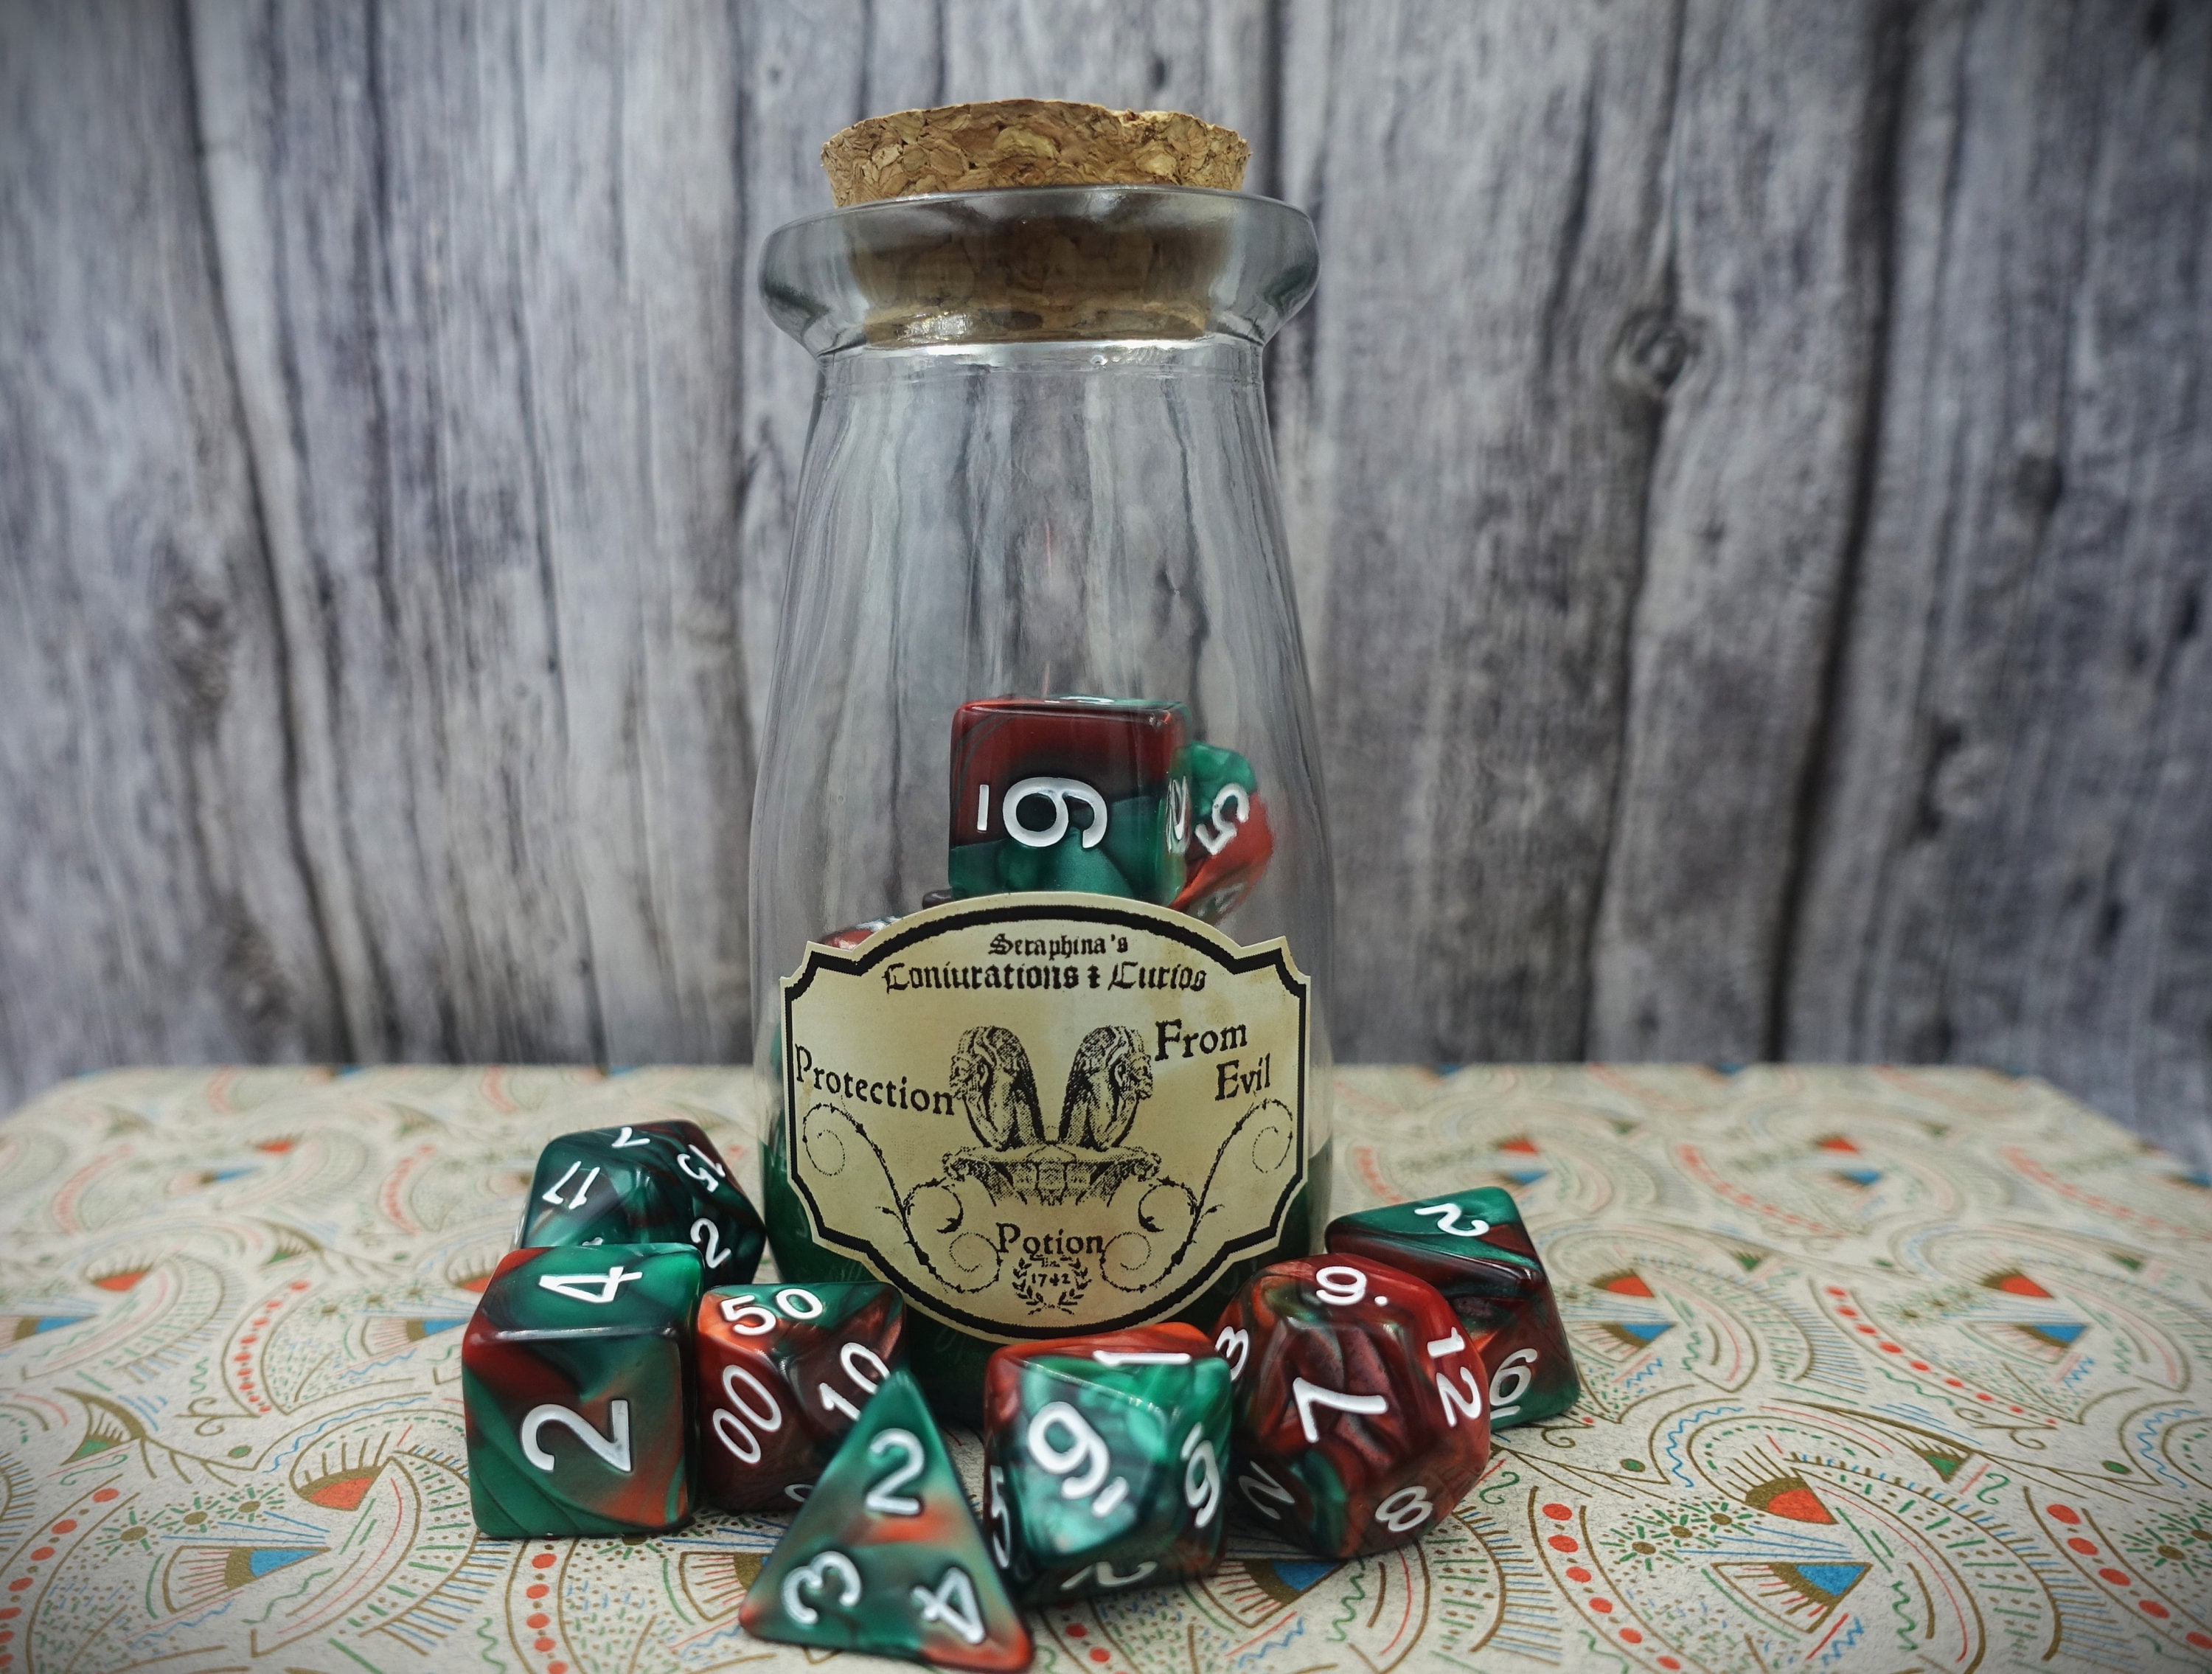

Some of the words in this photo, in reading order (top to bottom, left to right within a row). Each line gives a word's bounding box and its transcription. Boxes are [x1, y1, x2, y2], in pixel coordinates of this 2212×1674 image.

[988, 933, 1128, 961] Seraphina's
[1107, 961, 1207, 992] Curios
[1155, 1018, 1248, 1061] From
[795, 1043, 955, 1116] Protection
[1215, 1052, 1270, 1101] Evil
[677, 1144, 726, 1192] 15
[690, 1218, 732, 1268] 2
[995, 1222, 1104, 1255] Potion
[1414, 1203, 1490, 1237] 2
[538, 1265, 643, 1304] 4
[1032, 1273, 1071, 1288] 1742
[721, 1288, 824, 1336] 50
[1092, 1350, 1192, 1367] 1
[1215, 1326, 1249, 1382] 3
[1427, 1327, 1482, 1427] 12
[818, 1341, 891, 1420] 10
[712, 1364, 782, 1464] 00
[1293, 1377, 1388, 1443] 7
[521, 1398, 632, 1473] 2
[866, 1428, 925, 1516] 2
[1374, 1485, 1433, 1532] 8
[782, 1550, 862, 1625] 3
[911, 1566, 986, 1645] 4
